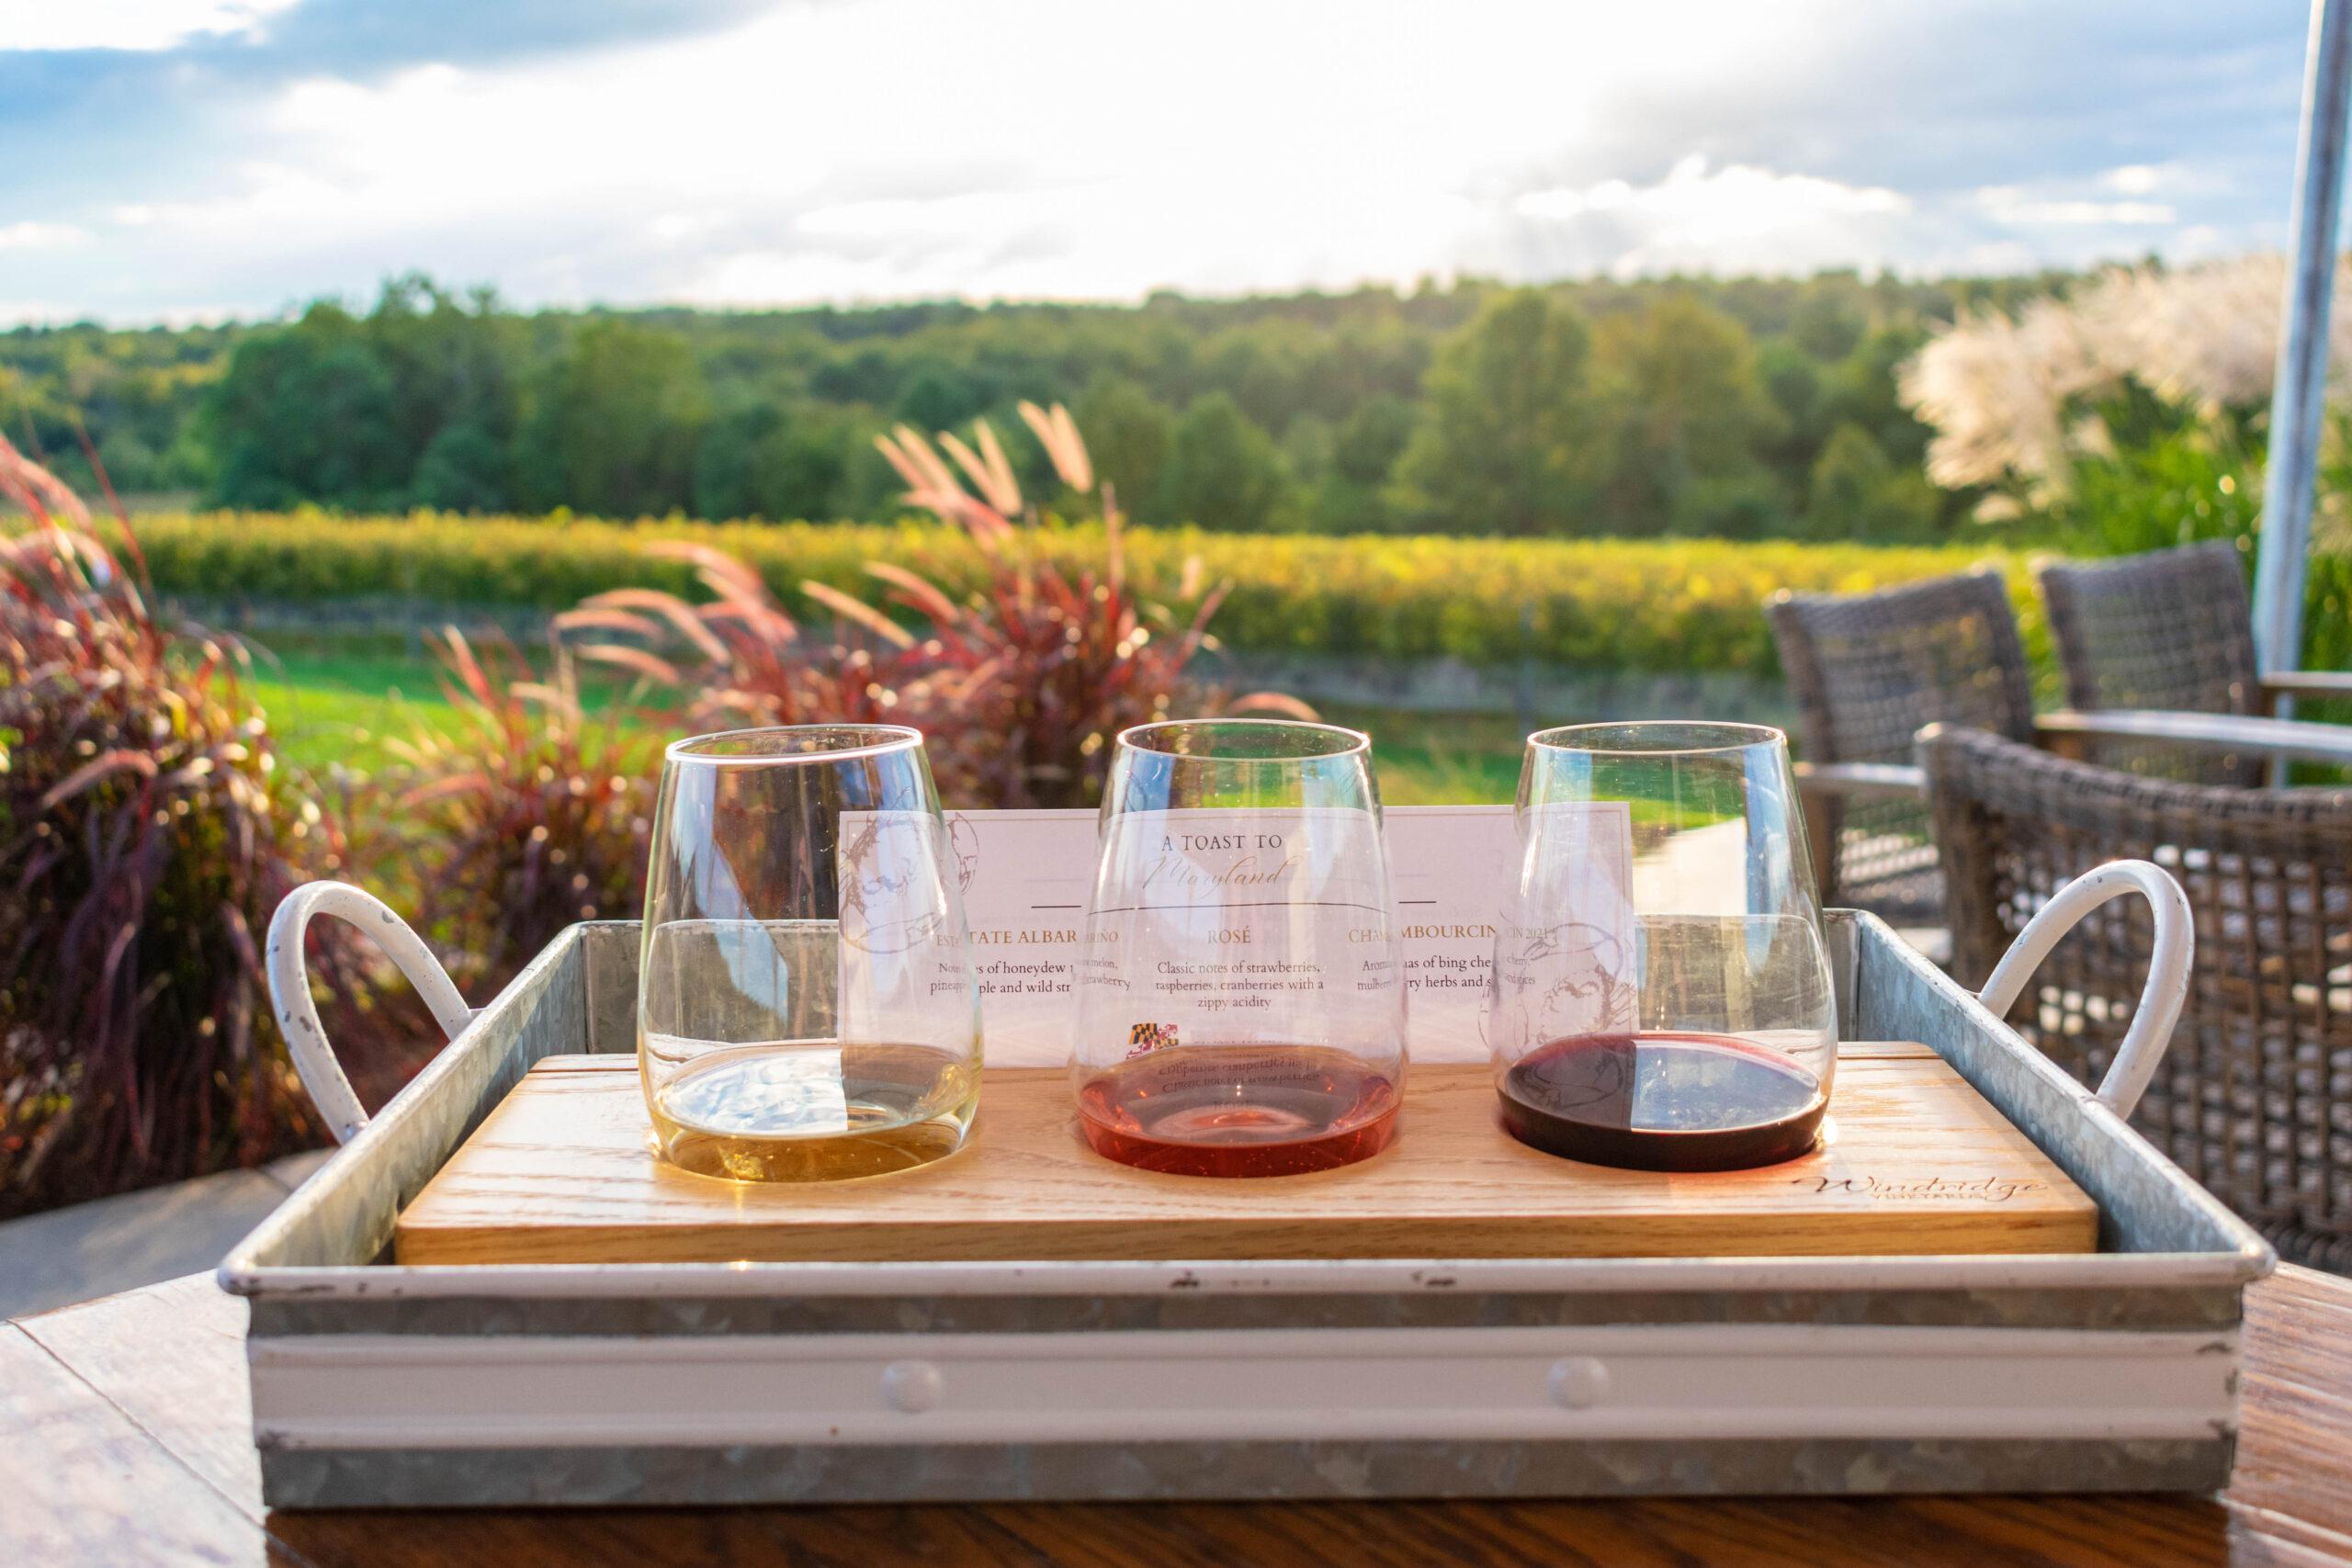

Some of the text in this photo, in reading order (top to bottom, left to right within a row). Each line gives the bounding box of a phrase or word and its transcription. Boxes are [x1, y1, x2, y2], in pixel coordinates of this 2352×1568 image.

[1161, 833, 1283, 852] A TOAST TO
[1142, 855, 1305, 899] Maryland
[1207, 925, 1252, 944] ROSÉ
[987, 960, 1001, 974] of
[1003, 960, 1066, 977] honeydew
[1157, 960, 1321, 975] Classic notes of strawberries,
[1422, 955, 1438, 968] of
[1439, 955, 1467, 972] bing
[1000, 979, 1022, 993] and
[1026, 979, 1053, 993] wild
[1156, 977, 1324, 994] raspberries, cranberries with a
[1425, 975, 1457, 988] herbs
[1461, 975, 1483, 987] and
[1197, 995, 1272, 1011] zippy acidity
[1792, 1175, 2049, 1202] Windridge
